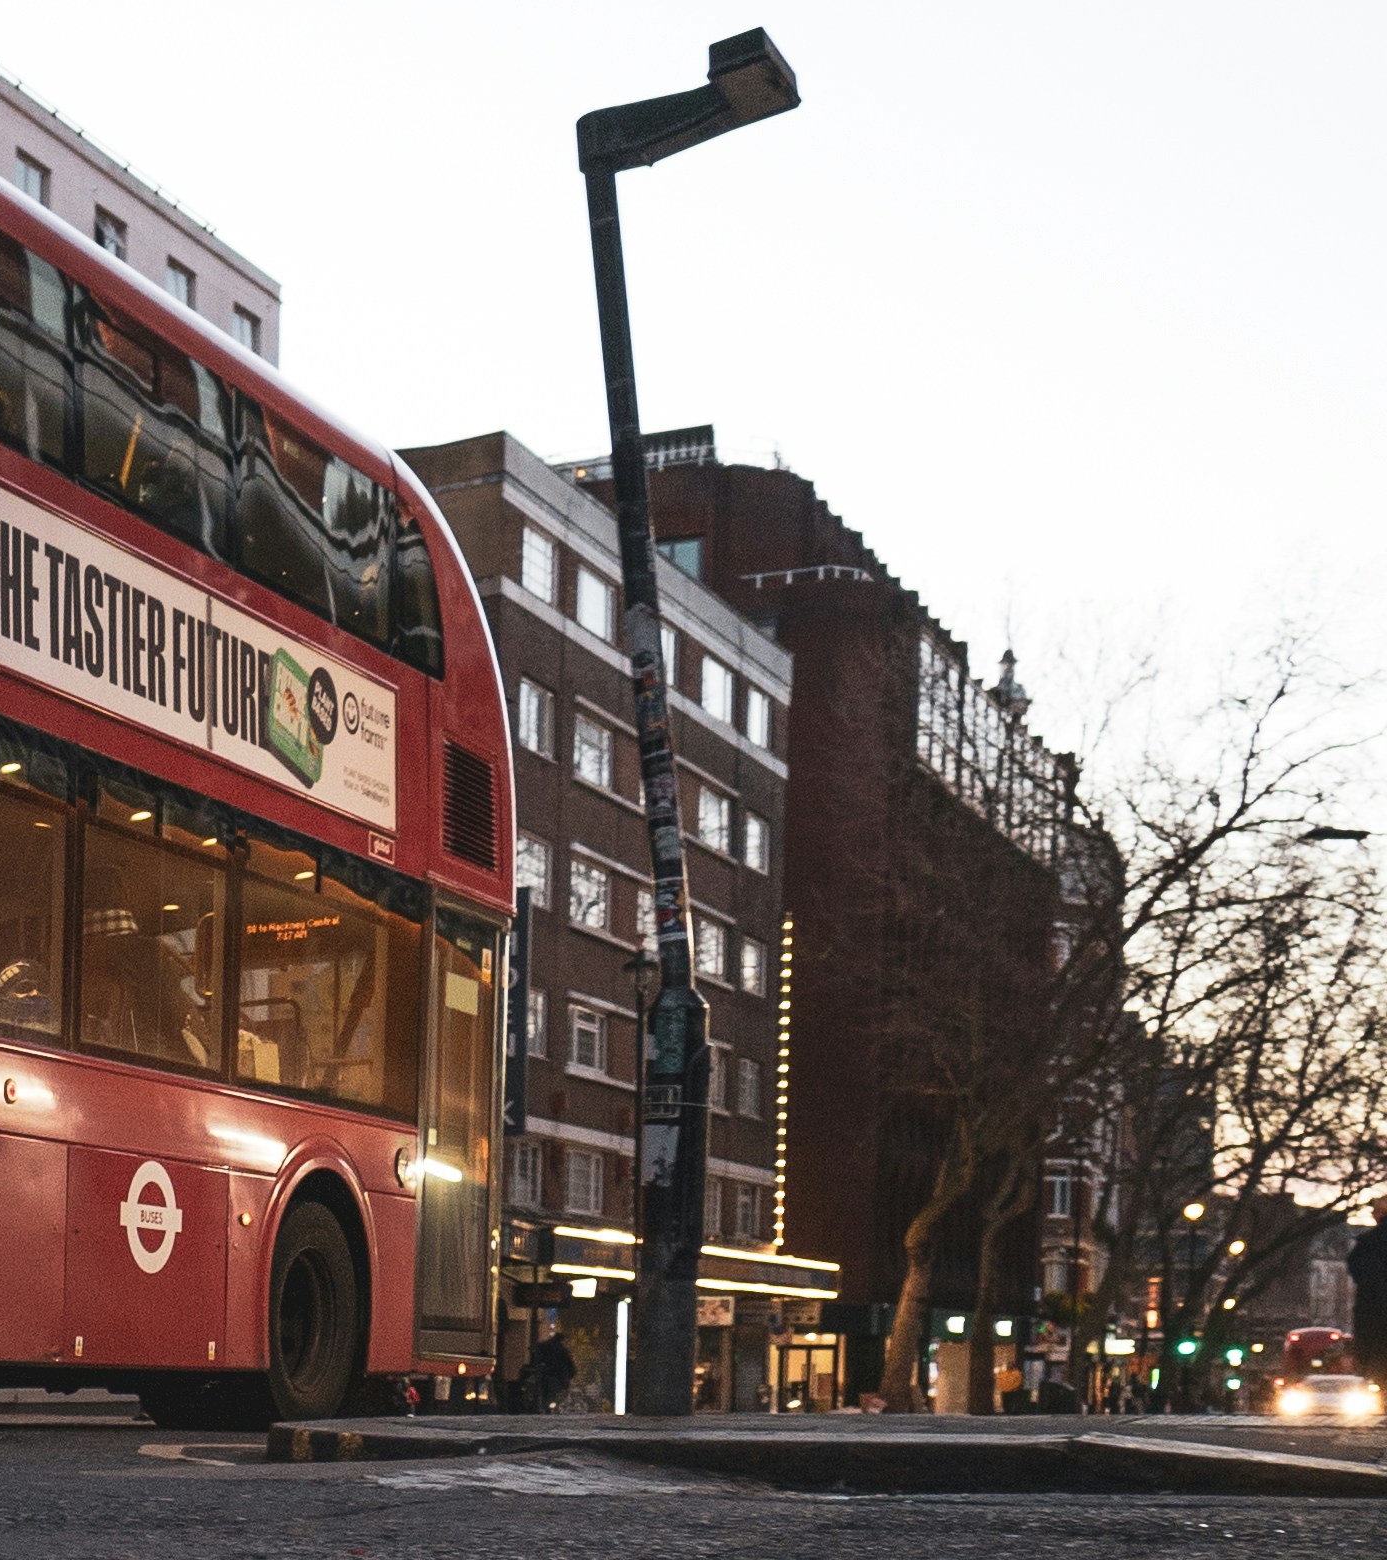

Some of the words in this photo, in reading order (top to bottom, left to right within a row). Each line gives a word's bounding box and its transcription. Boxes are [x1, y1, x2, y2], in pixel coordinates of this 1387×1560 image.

[44, 542, 167, 708] TASTIER
[361, 697, 391, 729] future
[140, 1209, 164, 1226] BUSES
